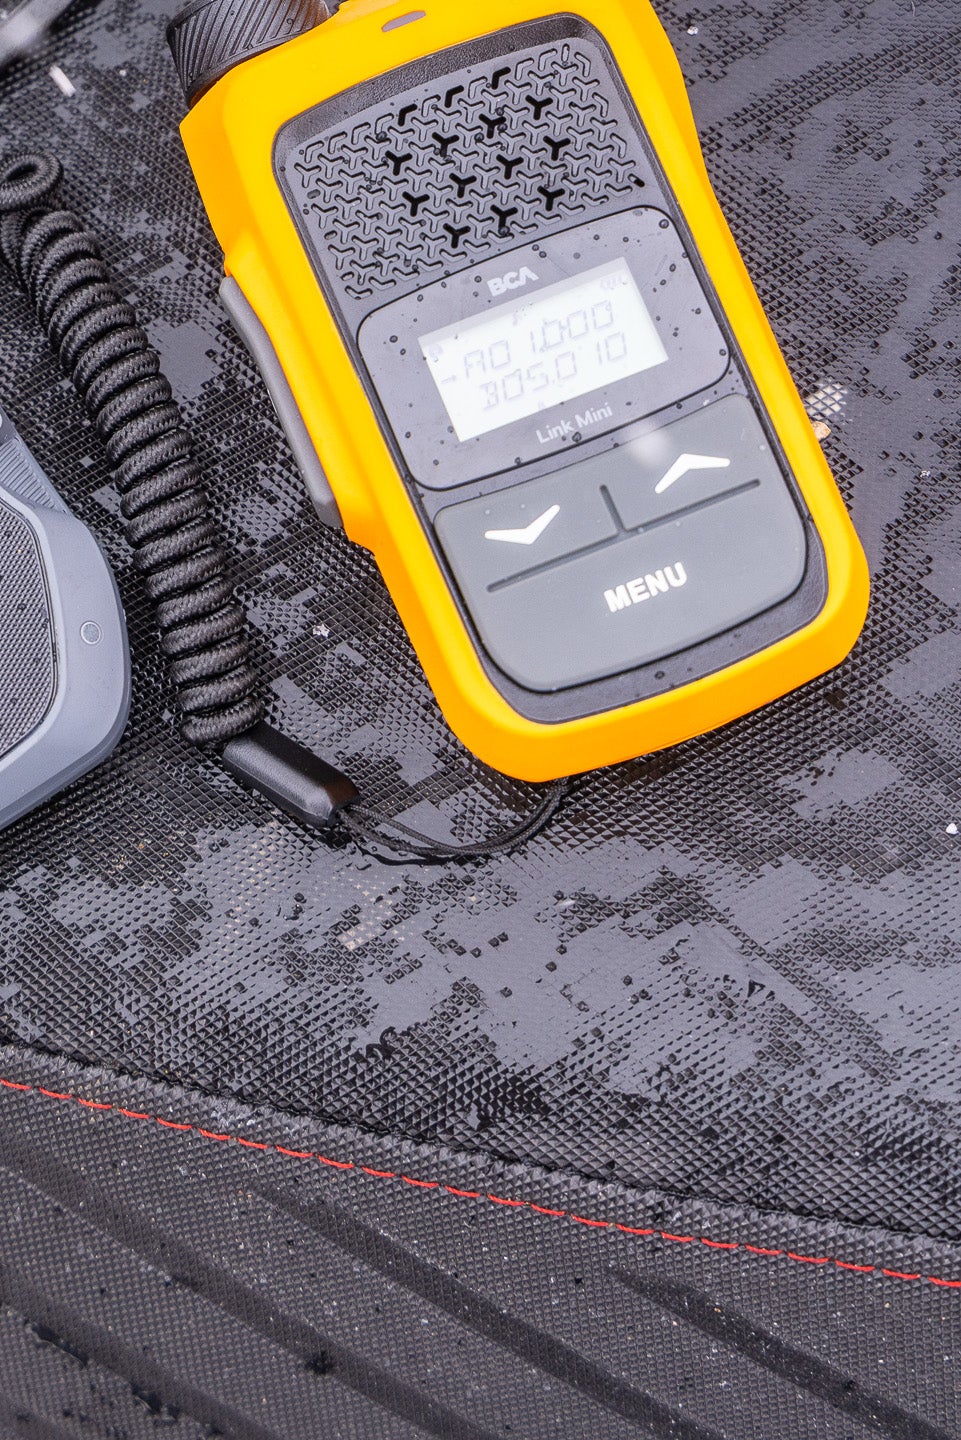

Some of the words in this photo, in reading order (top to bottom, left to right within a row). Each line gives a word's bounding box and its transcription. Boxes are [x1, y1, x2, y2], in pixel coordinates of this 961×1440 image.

[486, 266, 540, 297] BCA
[535, 419, 575, 444] Link
[574, 401, 613, 428] Mini
[603, 561, 688, 613] MENU
